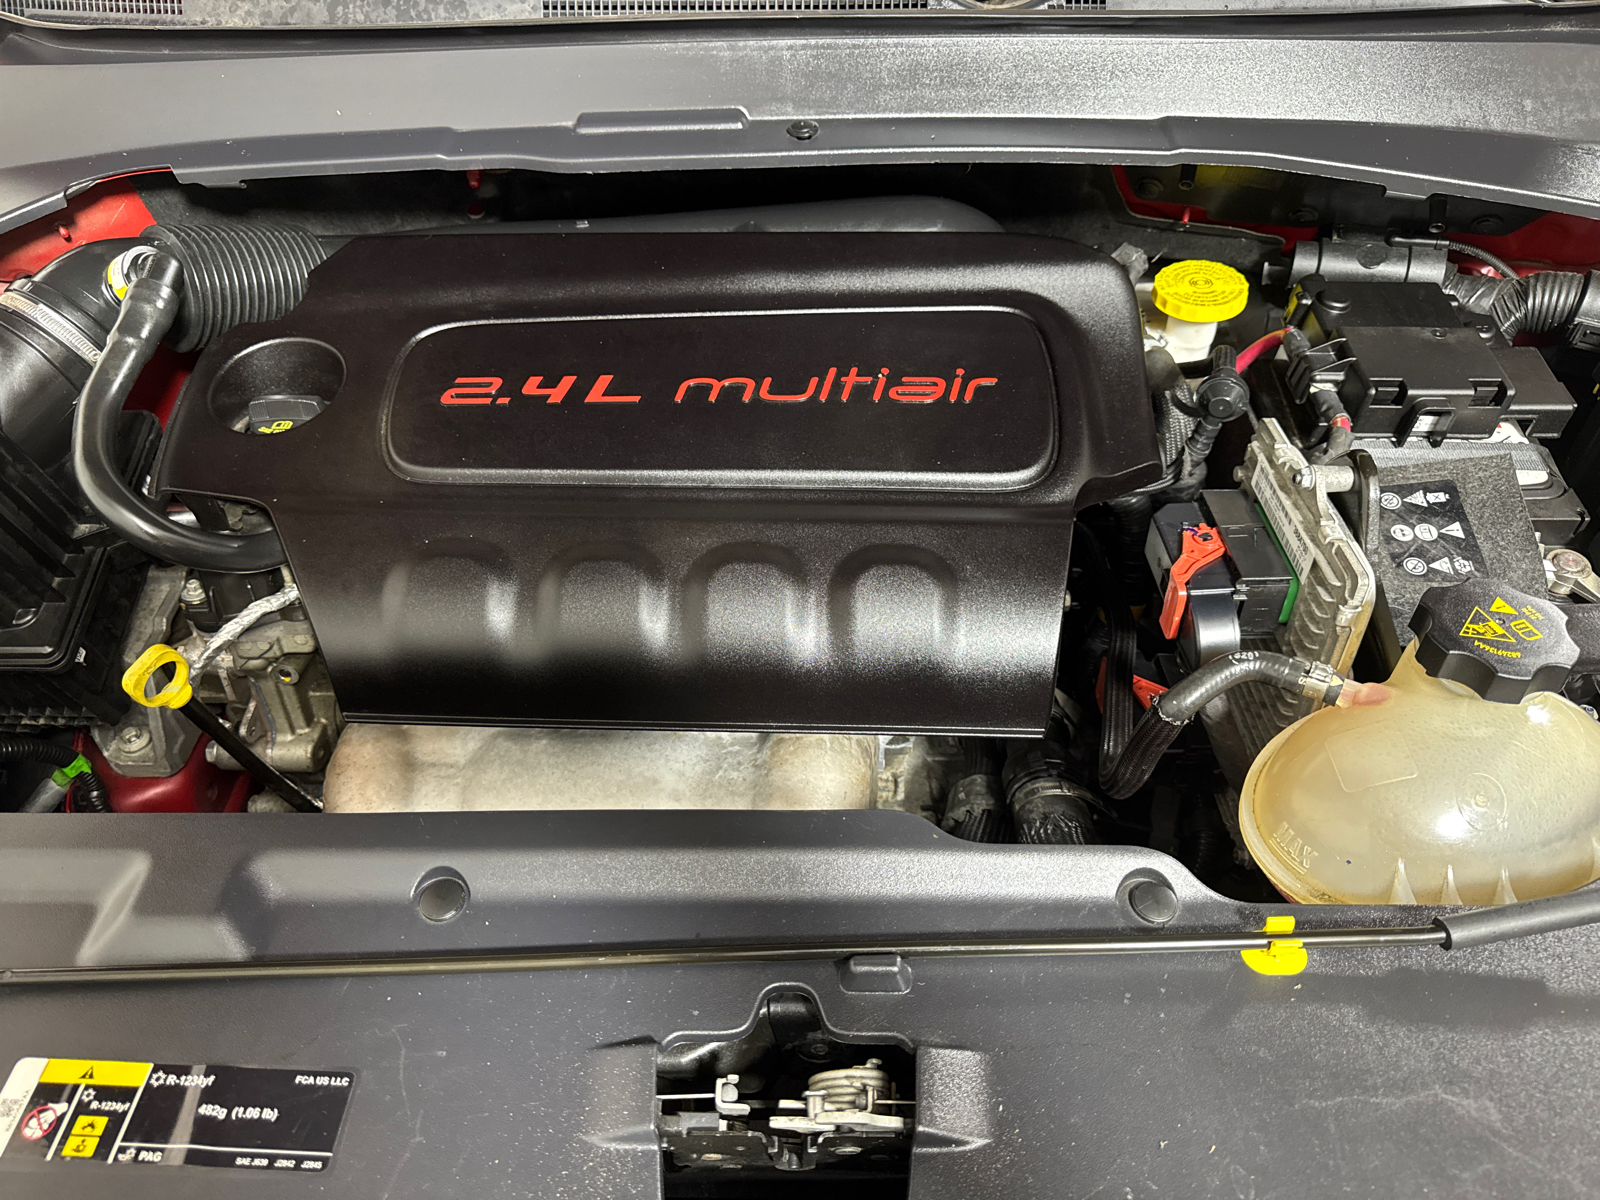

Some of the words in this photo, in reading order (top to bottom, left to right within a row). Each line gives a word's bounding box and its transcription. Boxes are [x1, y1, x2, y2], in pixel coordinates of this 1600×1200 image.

[674, 367, 998, 403] multiair
[1273, 821, 1319, 868] MAX
[165, 1074, 216, 1089] R-1234yf
[294, 1074, 315, 1085] FCA
[315, 1075, 330, 1086] US
[330, 1076, 350, 1087] LLC
[89, 1100, 131, 1113] R-1234yf
[197, 1103, 228, 1120] 482g
[231, 1106, 261, 1121] (1.06
[262, 1108, 279, 1121] lb)
[138, 1149, 163, 1162] PAG
[235, 1156, 252, 1166] SAE
